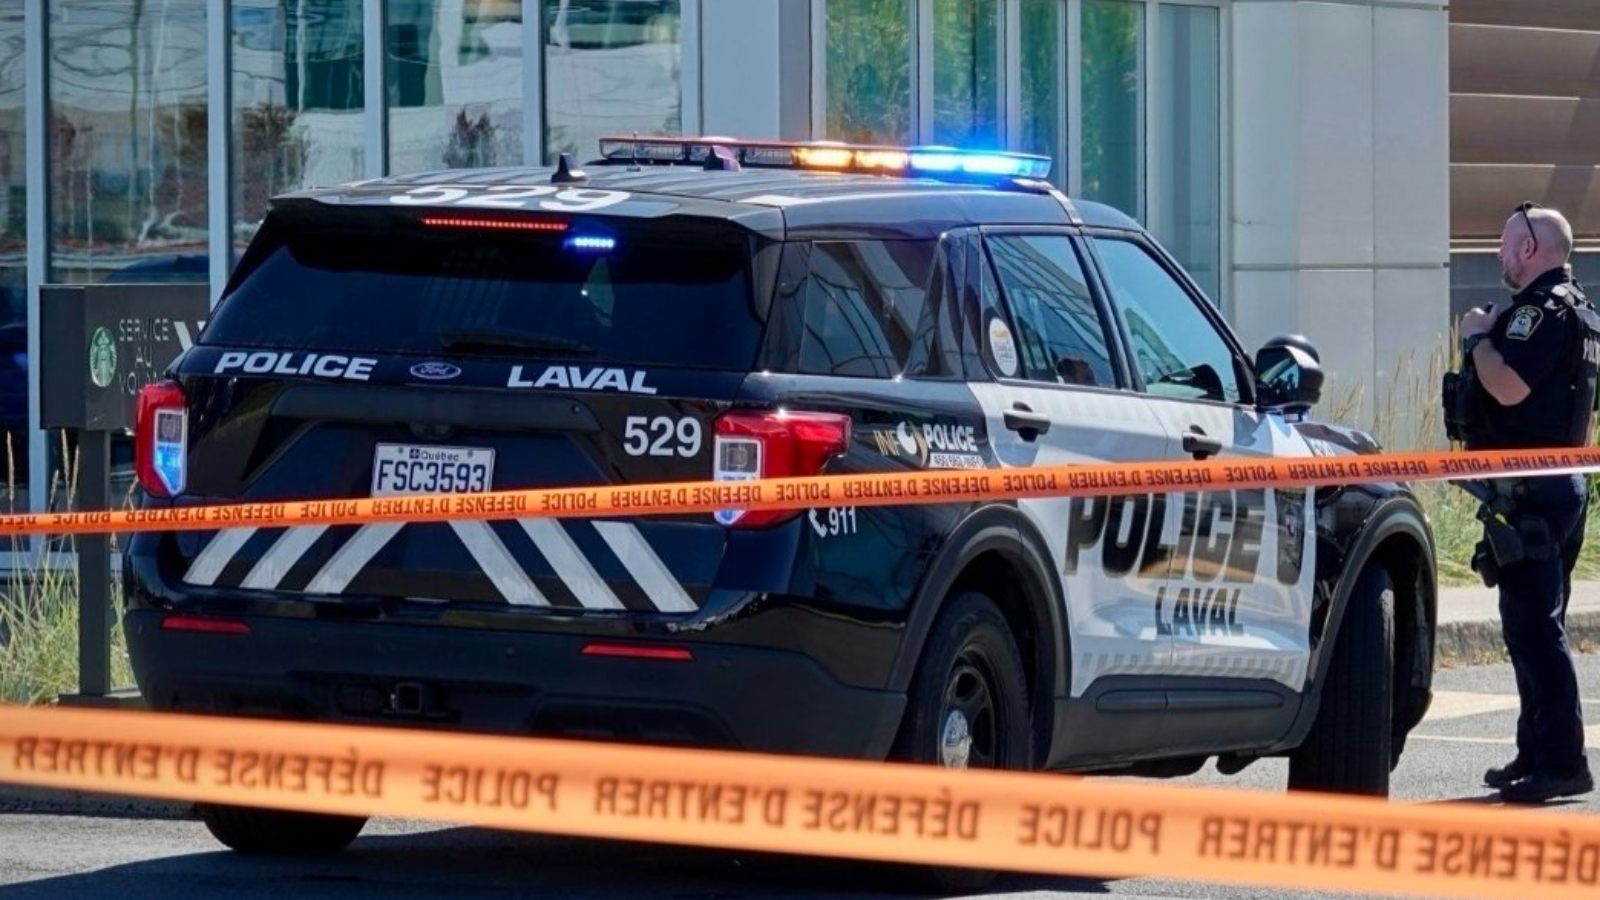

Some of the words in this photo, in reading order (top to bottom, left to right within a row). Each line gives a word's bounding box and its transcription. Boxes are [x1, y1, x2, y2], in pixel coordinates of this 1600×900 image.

[390, 184, 631, 211] 529
[119, 318, 169, 341] SERVICE
[135, 346, 152, 368] AU
[214, 352, 378, 381] POLICE
[507, 365, 658, 394] LAVAL
[623, 416, 701, 458] 529
[922, 423, 979, 452] POLICE
[421, 451, 459, 462] Québec
[1441, 457, 1491, 473] POLICE
[377, 459, 487, 494] FSC3593
[1068, 469, 1141, 489] D'ENTRER
[1224, 464, 1277, 481] POLICE
[1287, 461, 1361, 479] D'ENTRER
[776, 482, 830, 501] POLICE
[843, 478, 917, 498] D'ENTRER
[1004, 473, 1057, 491] POLICE
[372, 498, 450, 516] D'ENTRER
[542, 492, 597, 511] POLICE
[611, 487, 687, 508] D'ENTRER
[301, 500, 358, 518] POLICE
[829, 505, 857, 536] 911
[1064, 488, 1266, 583] POLICE
[1155, 586, 1243, 636] LAVAL
